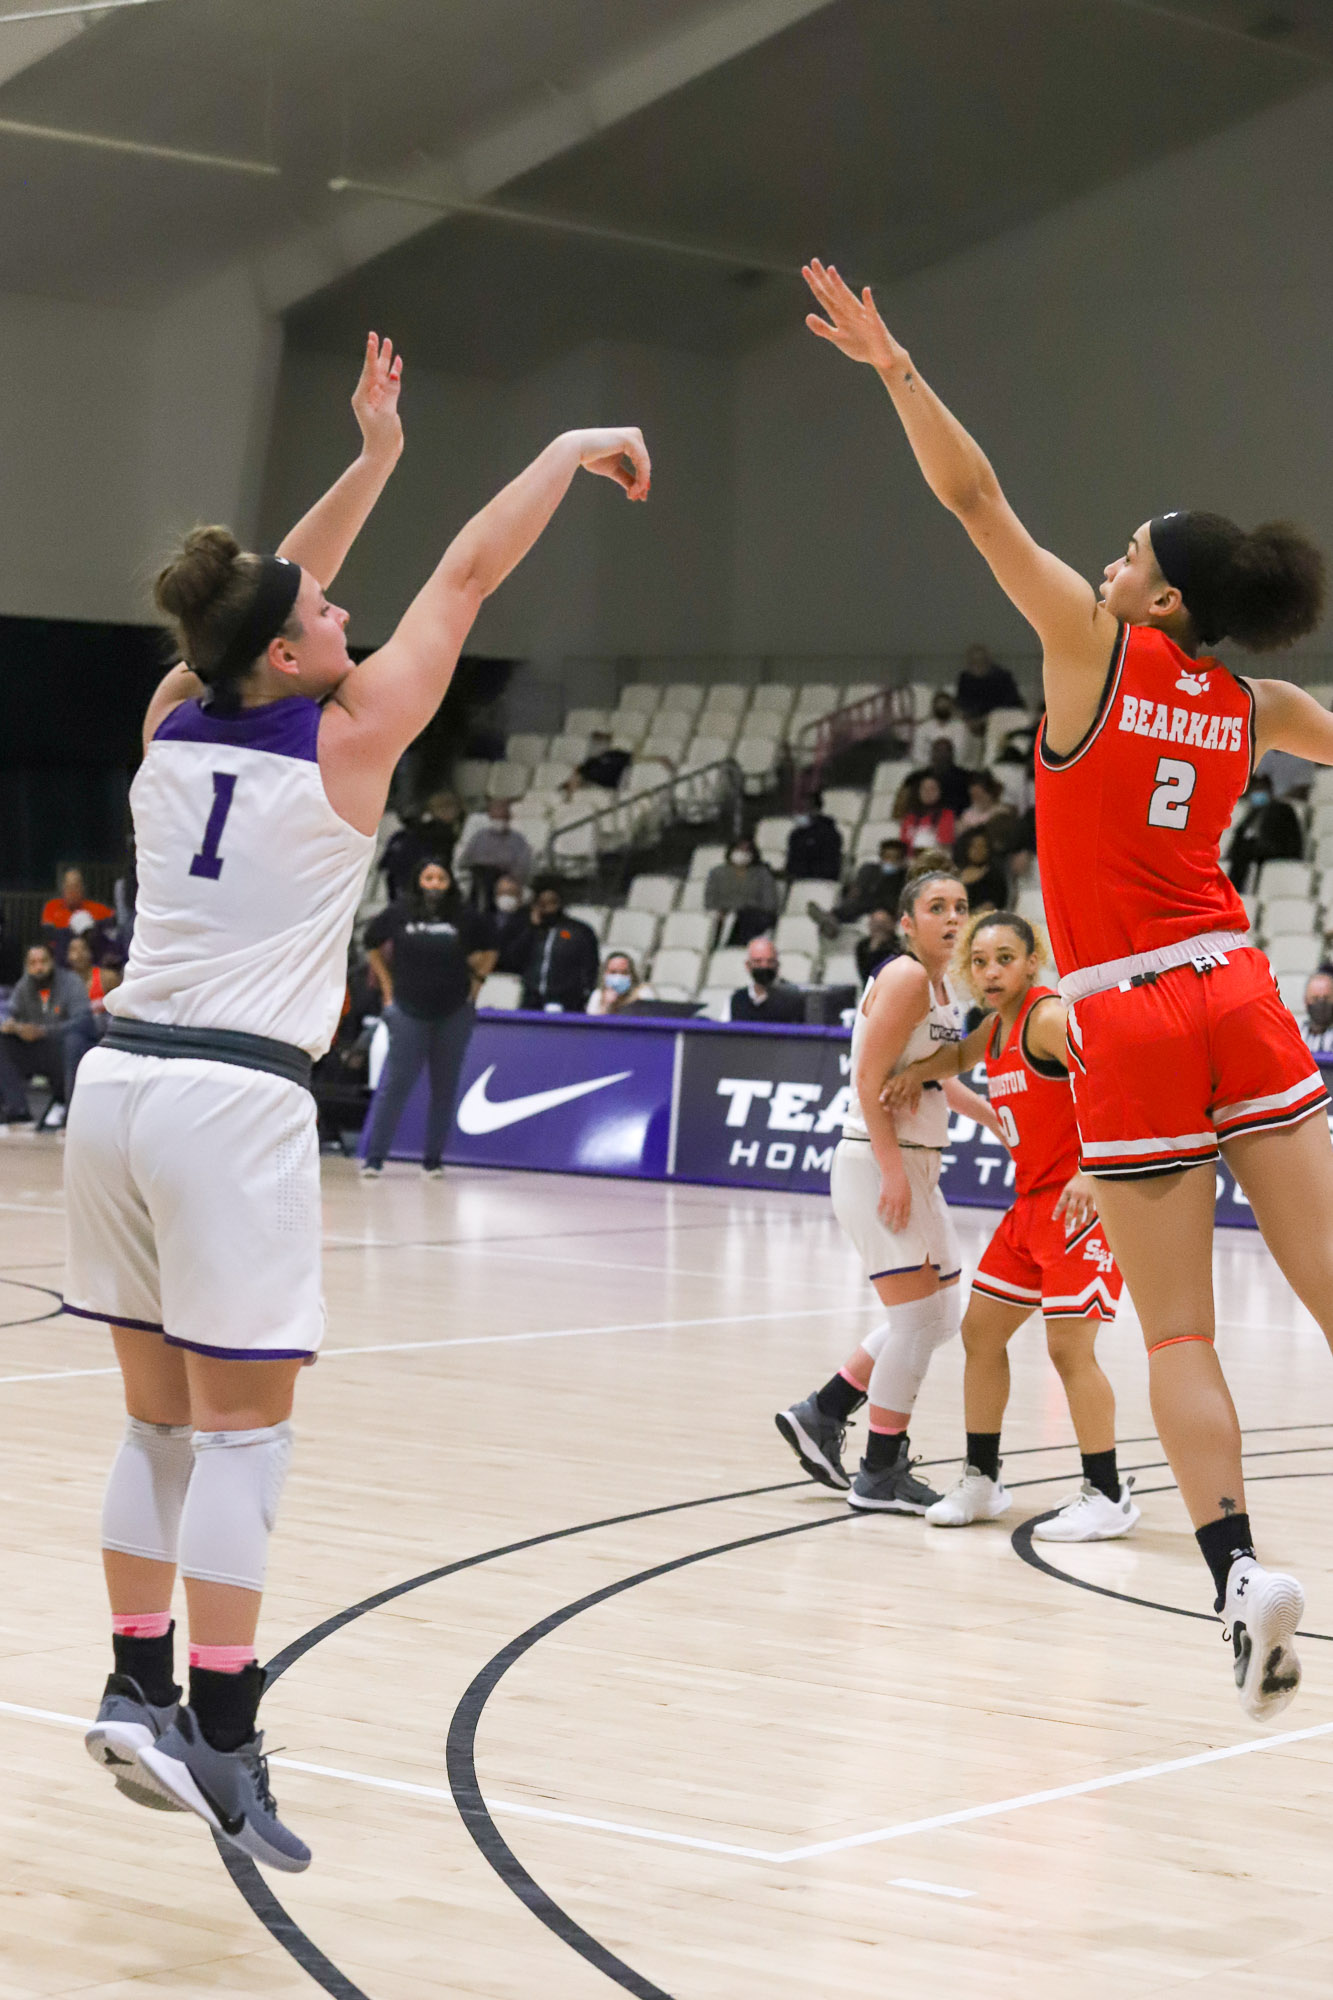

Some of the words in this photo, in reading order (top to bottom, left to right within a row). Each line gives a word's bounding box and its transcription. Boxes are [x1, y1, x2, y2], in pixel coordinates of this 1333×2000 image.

[1118, 694, 1243, 752] BEARKATS
[188, 771, 238, 880] 1
[1146, 756, 1197, 830] 2
[729, 1140, 833, 1172] HOM
